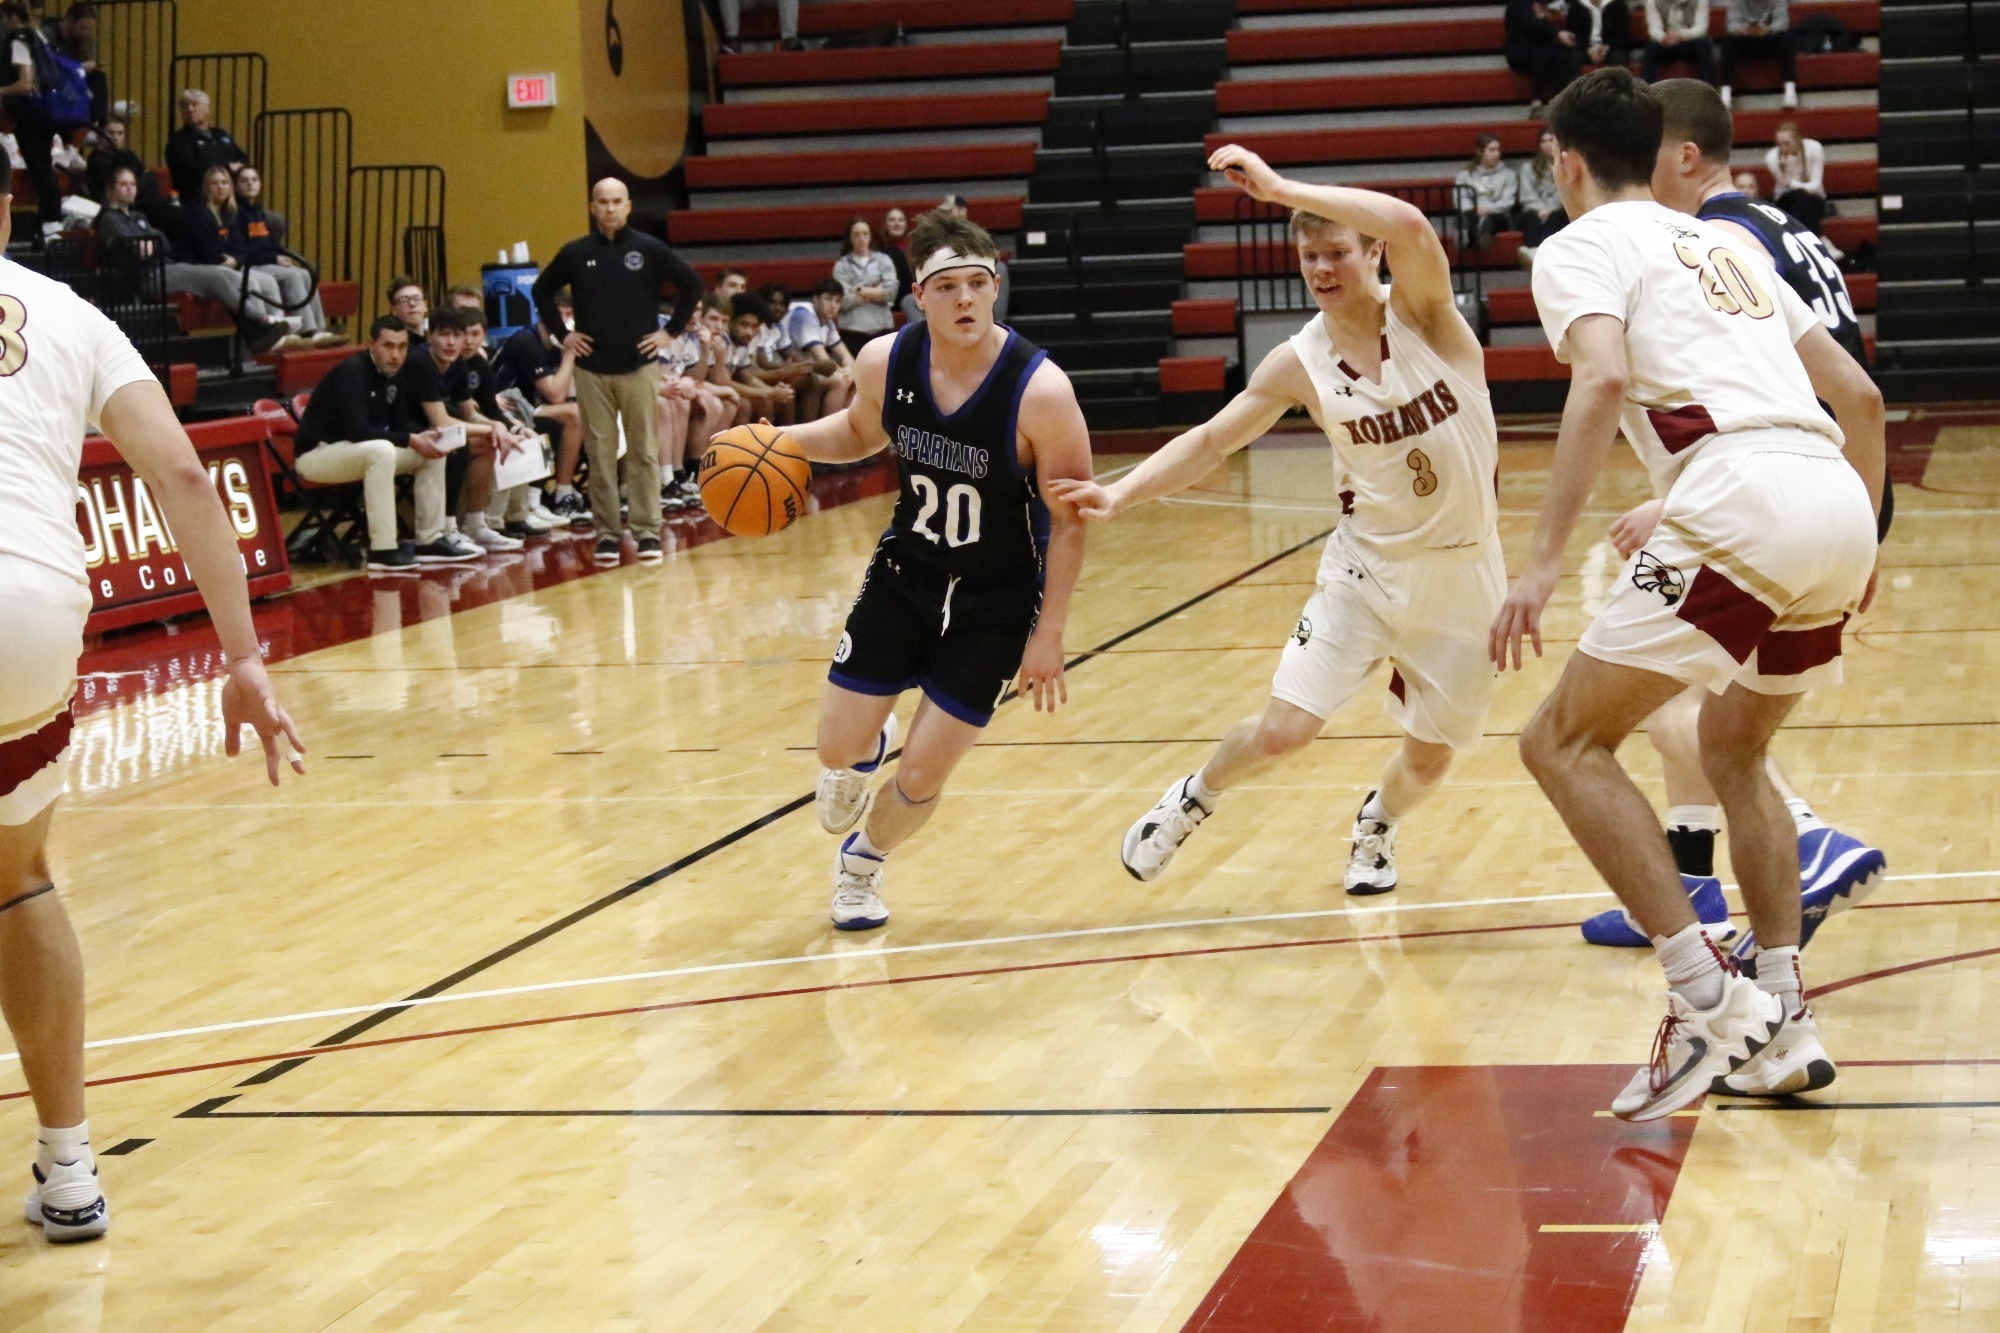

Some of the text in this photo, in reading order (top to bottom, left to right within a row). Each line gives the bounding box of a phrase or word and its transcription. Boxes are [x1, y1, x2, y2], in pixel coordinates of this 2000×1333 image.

[515, 78, 545, 102] EXIT
[1782, 230, 1858, 330] 35
[1339, 378, 1459, 446] KOHAWKS
[897, 424, 989, 480] SPARTANS
[1406, 447, 1438, 497] 3
[910, 474, 982, 549] 20
